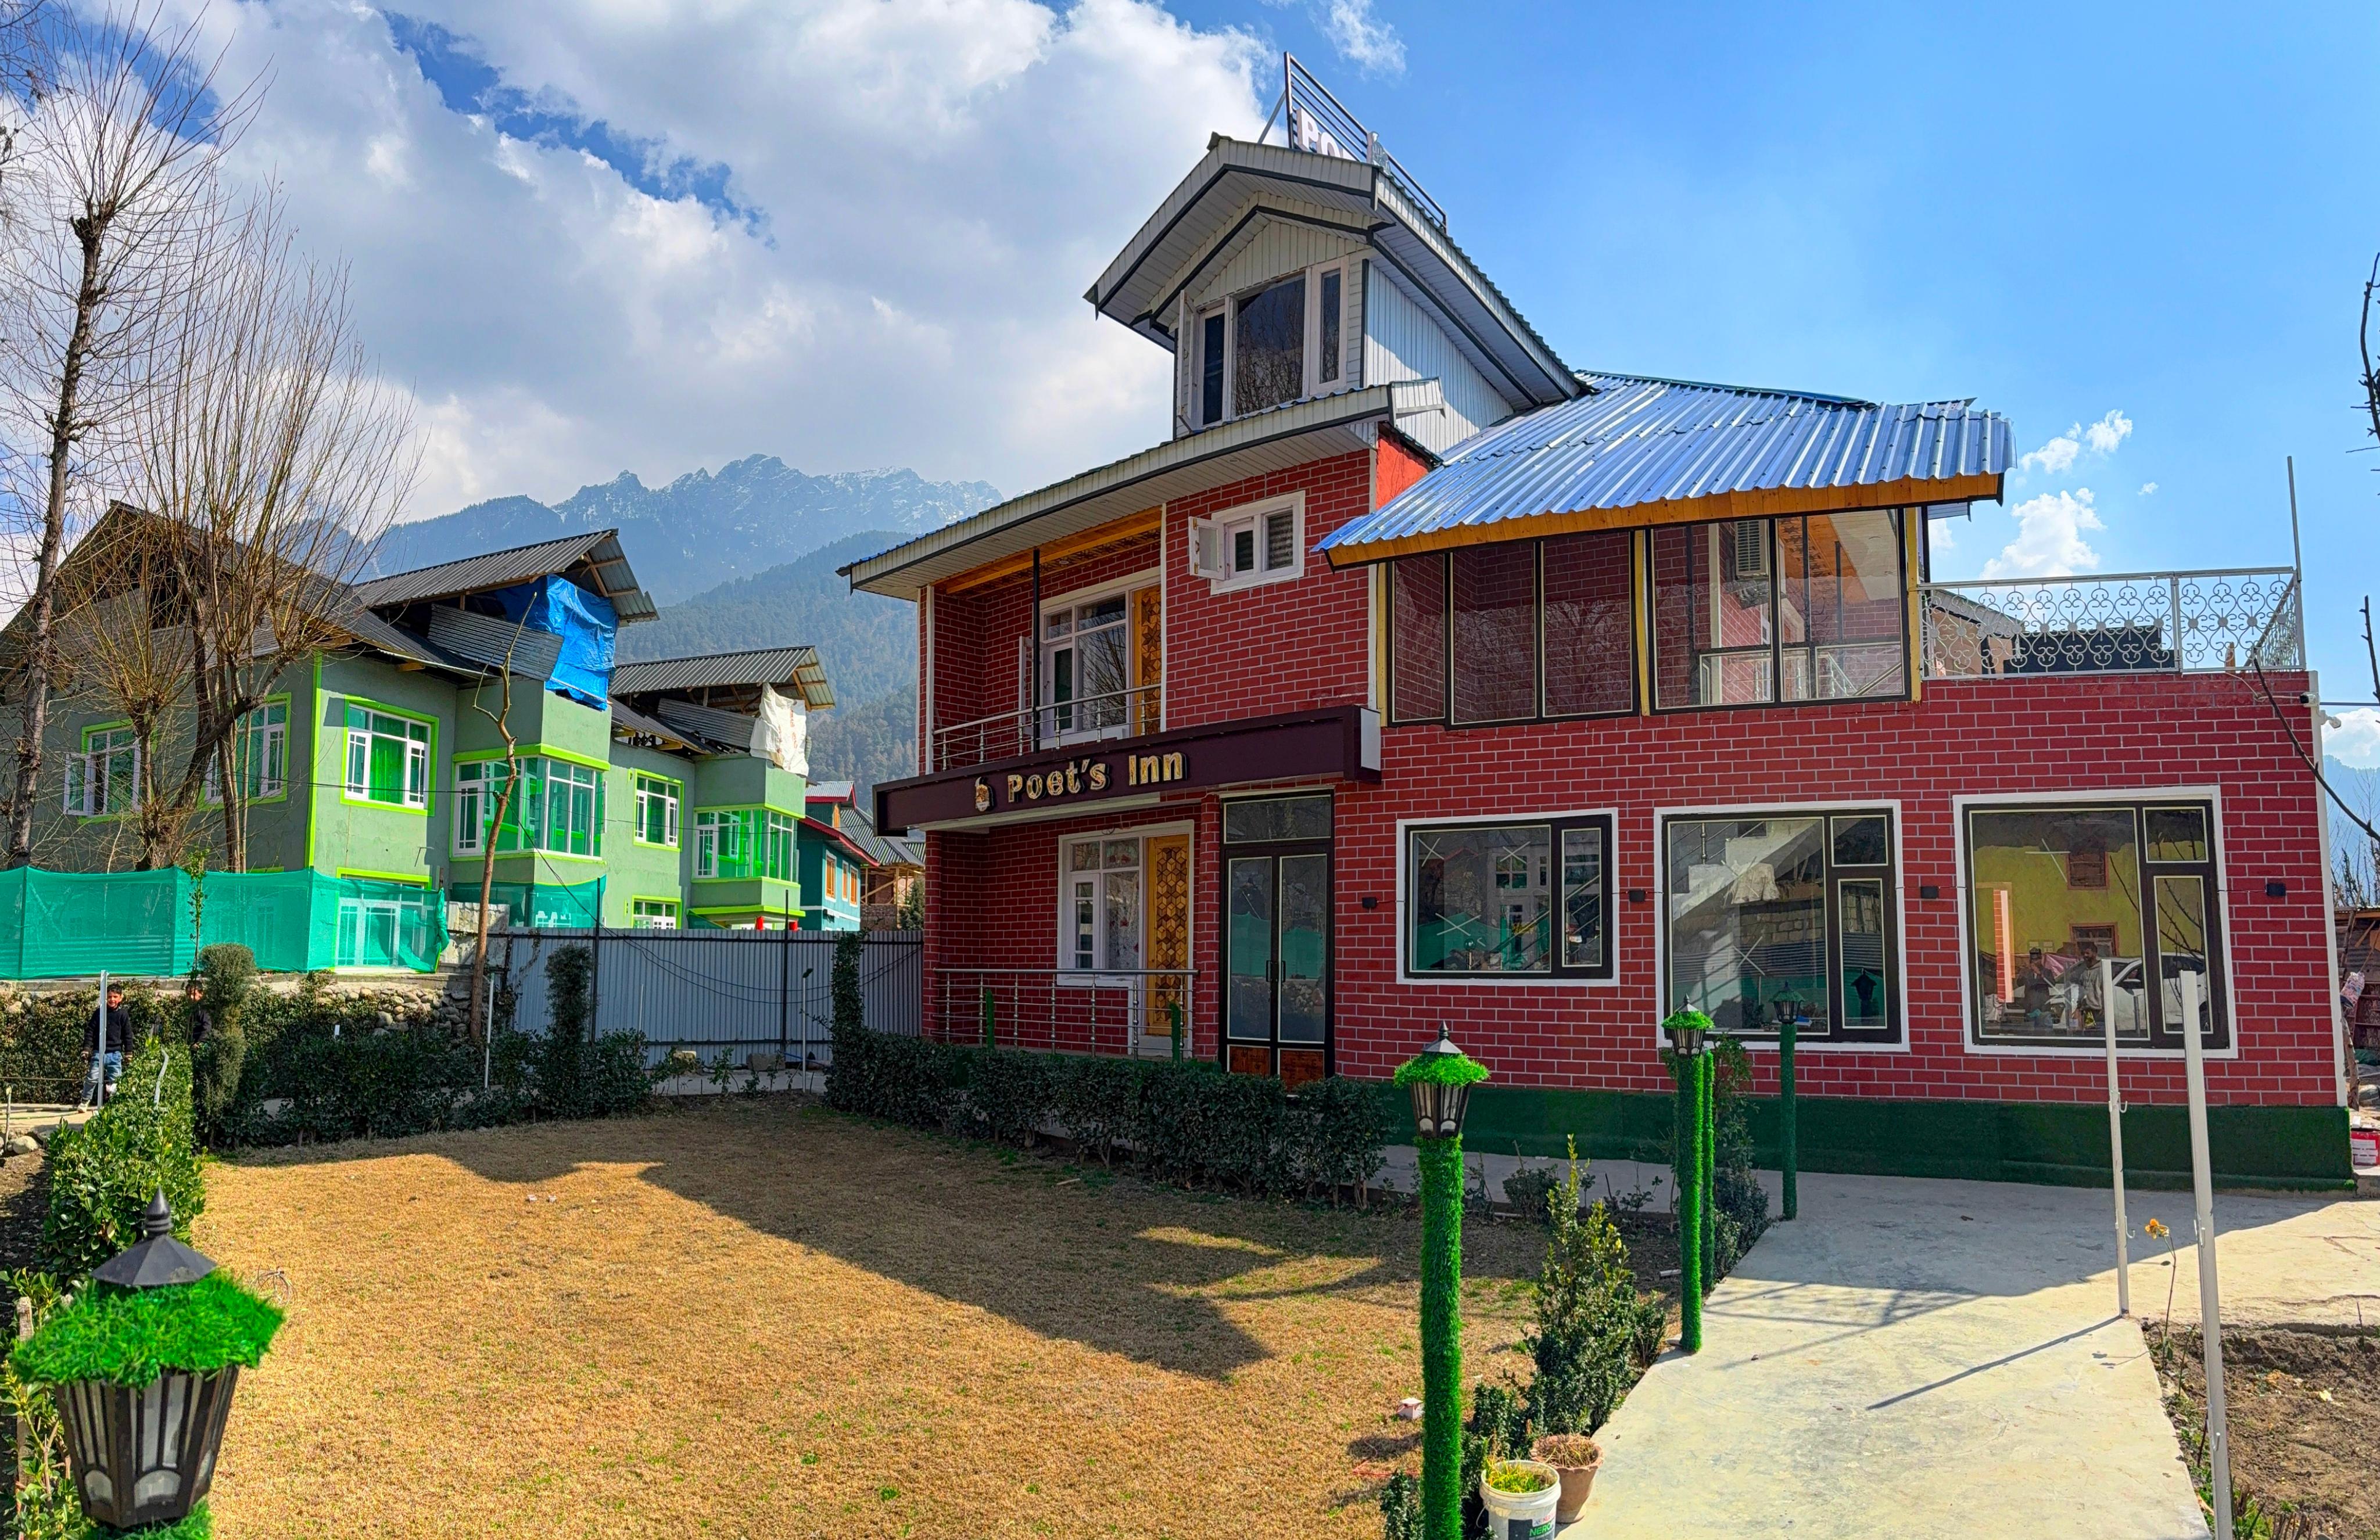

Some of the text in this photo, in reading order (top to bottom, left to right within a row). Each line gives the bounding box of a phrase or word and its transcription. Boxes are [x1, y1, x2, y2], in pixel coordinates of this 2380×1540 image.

[1007, 752, 1184, 803] Poet's Inn
[1529, 1523, 1552, 1537] NERO
